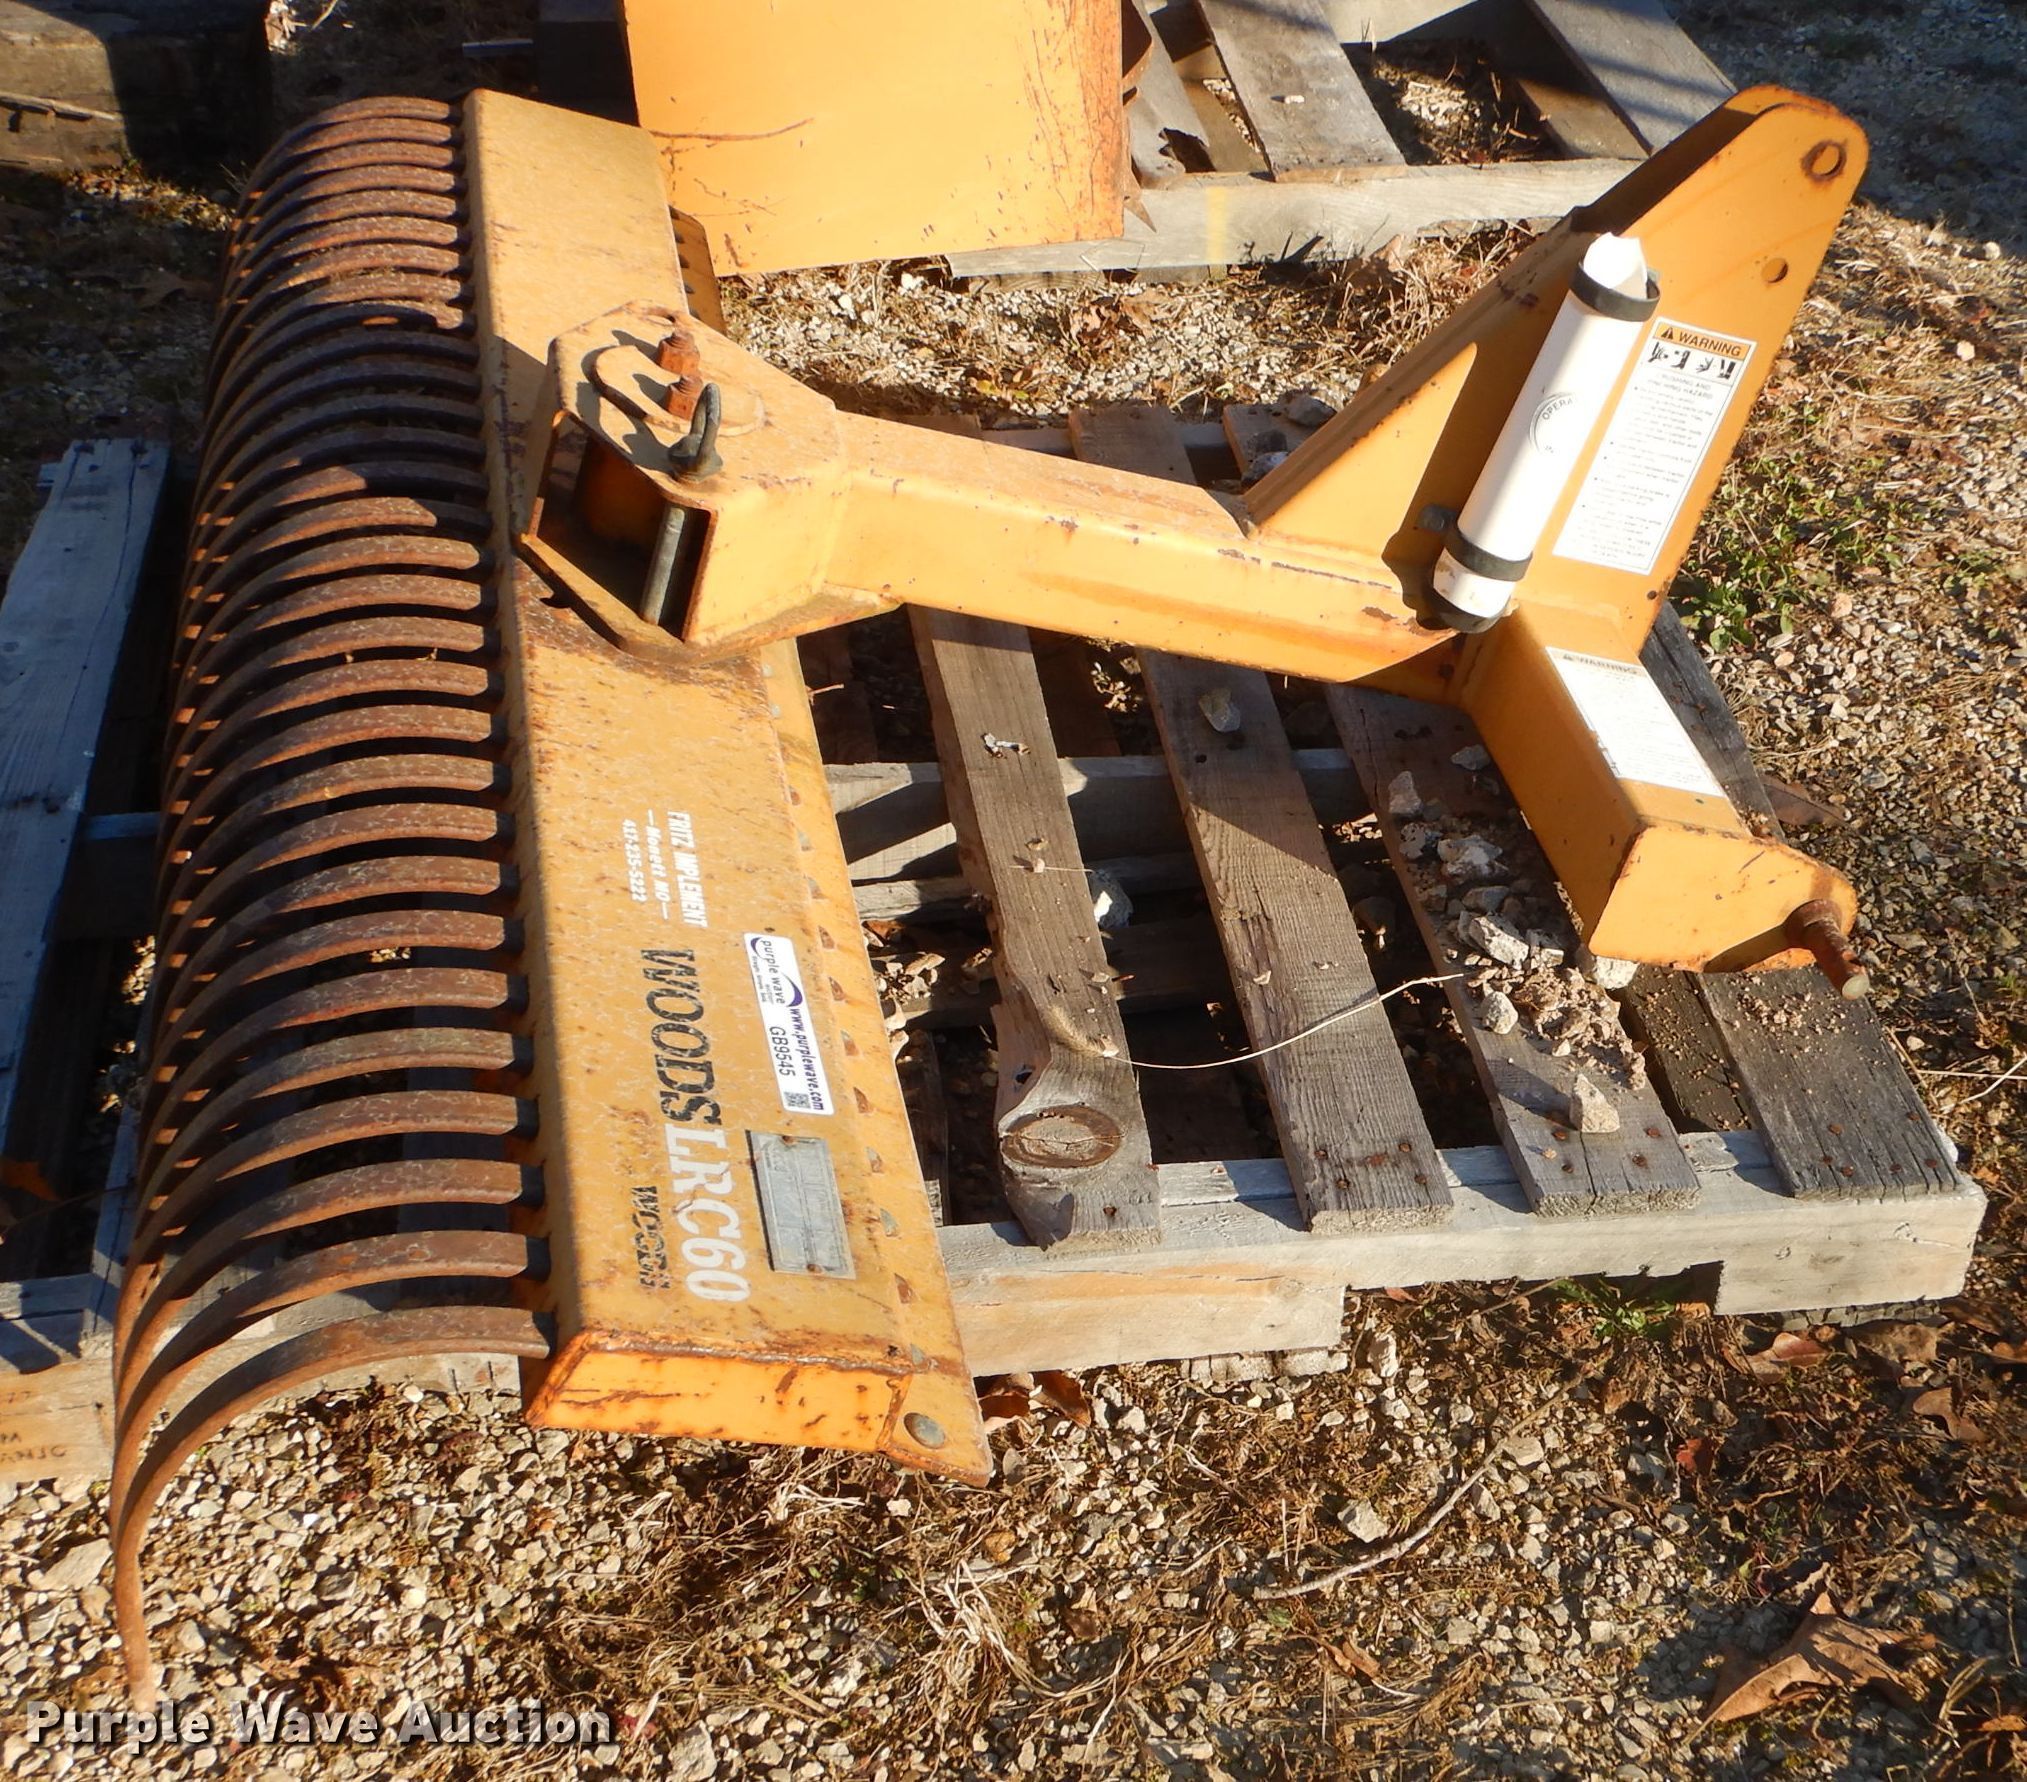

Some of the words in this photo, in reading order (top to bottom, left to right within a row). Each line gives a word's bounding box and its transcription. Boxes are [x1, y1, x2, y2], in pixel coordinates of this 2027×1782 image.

[1678, 331, 1743, 358] WARNING
[622, 819, 648, 902] 417-235-5222
[667, 811, 695, 848] FRITZ
[673, 851, 708, 928] IMPLEMENT
[761, 940, 779, 974] purple
[773, 974, 786, 1005] wave
[641, 949, 723, 1126] WOODS
[769, 1026, 796, 1077] GB9545
[789, 1008, 825, 1111] www.purplewave.com
[665, 1123, 751, 1301] LRC60
